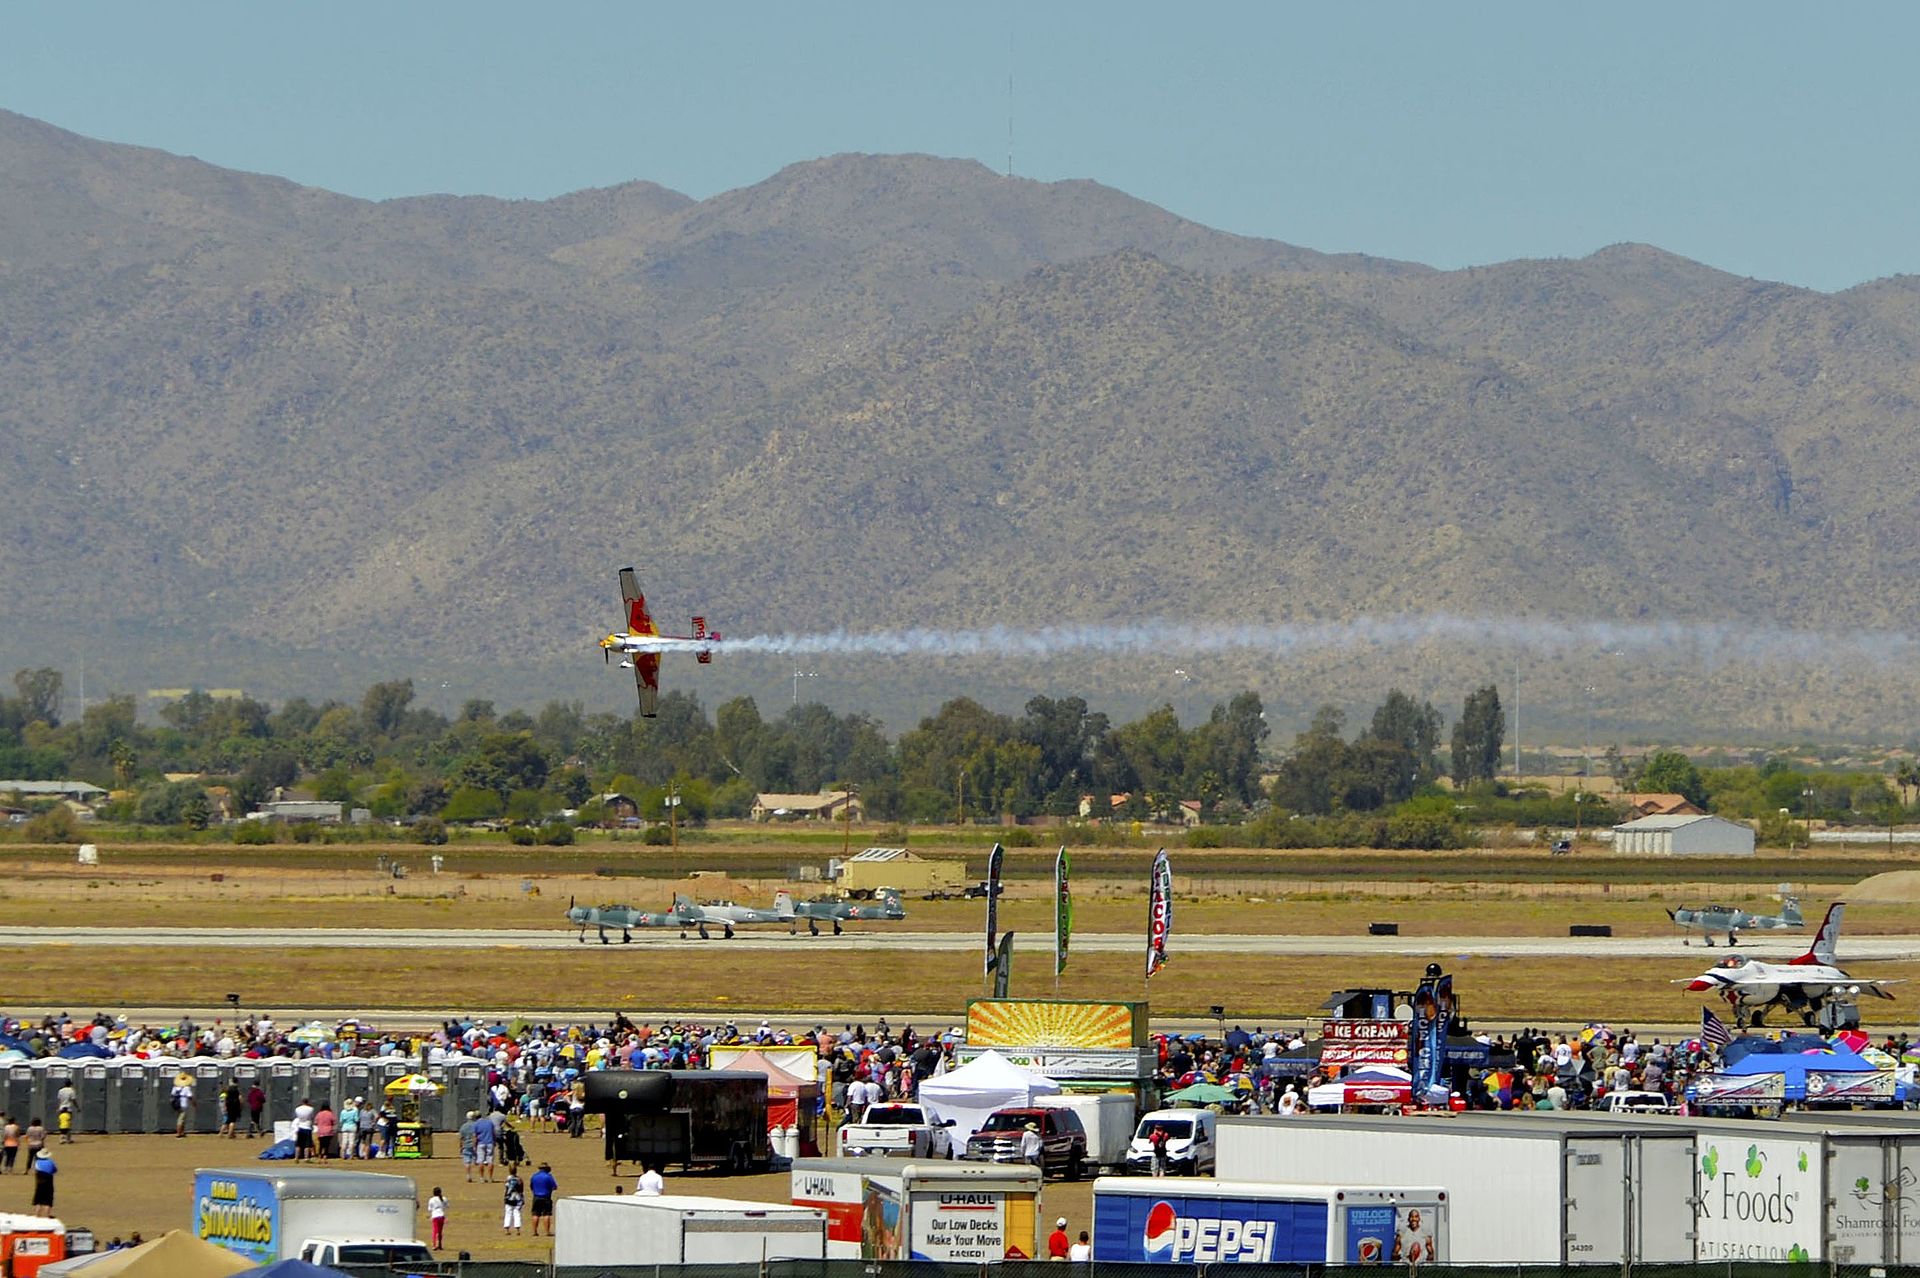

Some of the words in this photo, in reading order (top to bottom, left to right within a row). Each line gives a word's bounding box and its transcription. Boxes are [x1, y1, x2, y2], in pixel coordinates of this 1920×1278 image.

[692, 616, 705, 639] Bull
[1334, 1025, 1351, 1037] ICE
[1354, 1025, 1398, 1038] CREAM
[940, 1194, 995, 1204] U-HAUL
[1722, 1171, 1794, 1224] Foods
[200, 1195, 272, 1245] Smoothies
[932, 1219, 947, 1230] Our
[949, 1219, 967, 1231] Low
[969, 1219, 998, 1231] Decks
[927, 1234, 952, 1245] Make
[954, 1234, 974, 1246] Your
[976, 1234, 1001, 1246] Move
[1171, 1217, 1276, 1262] PEPSI
